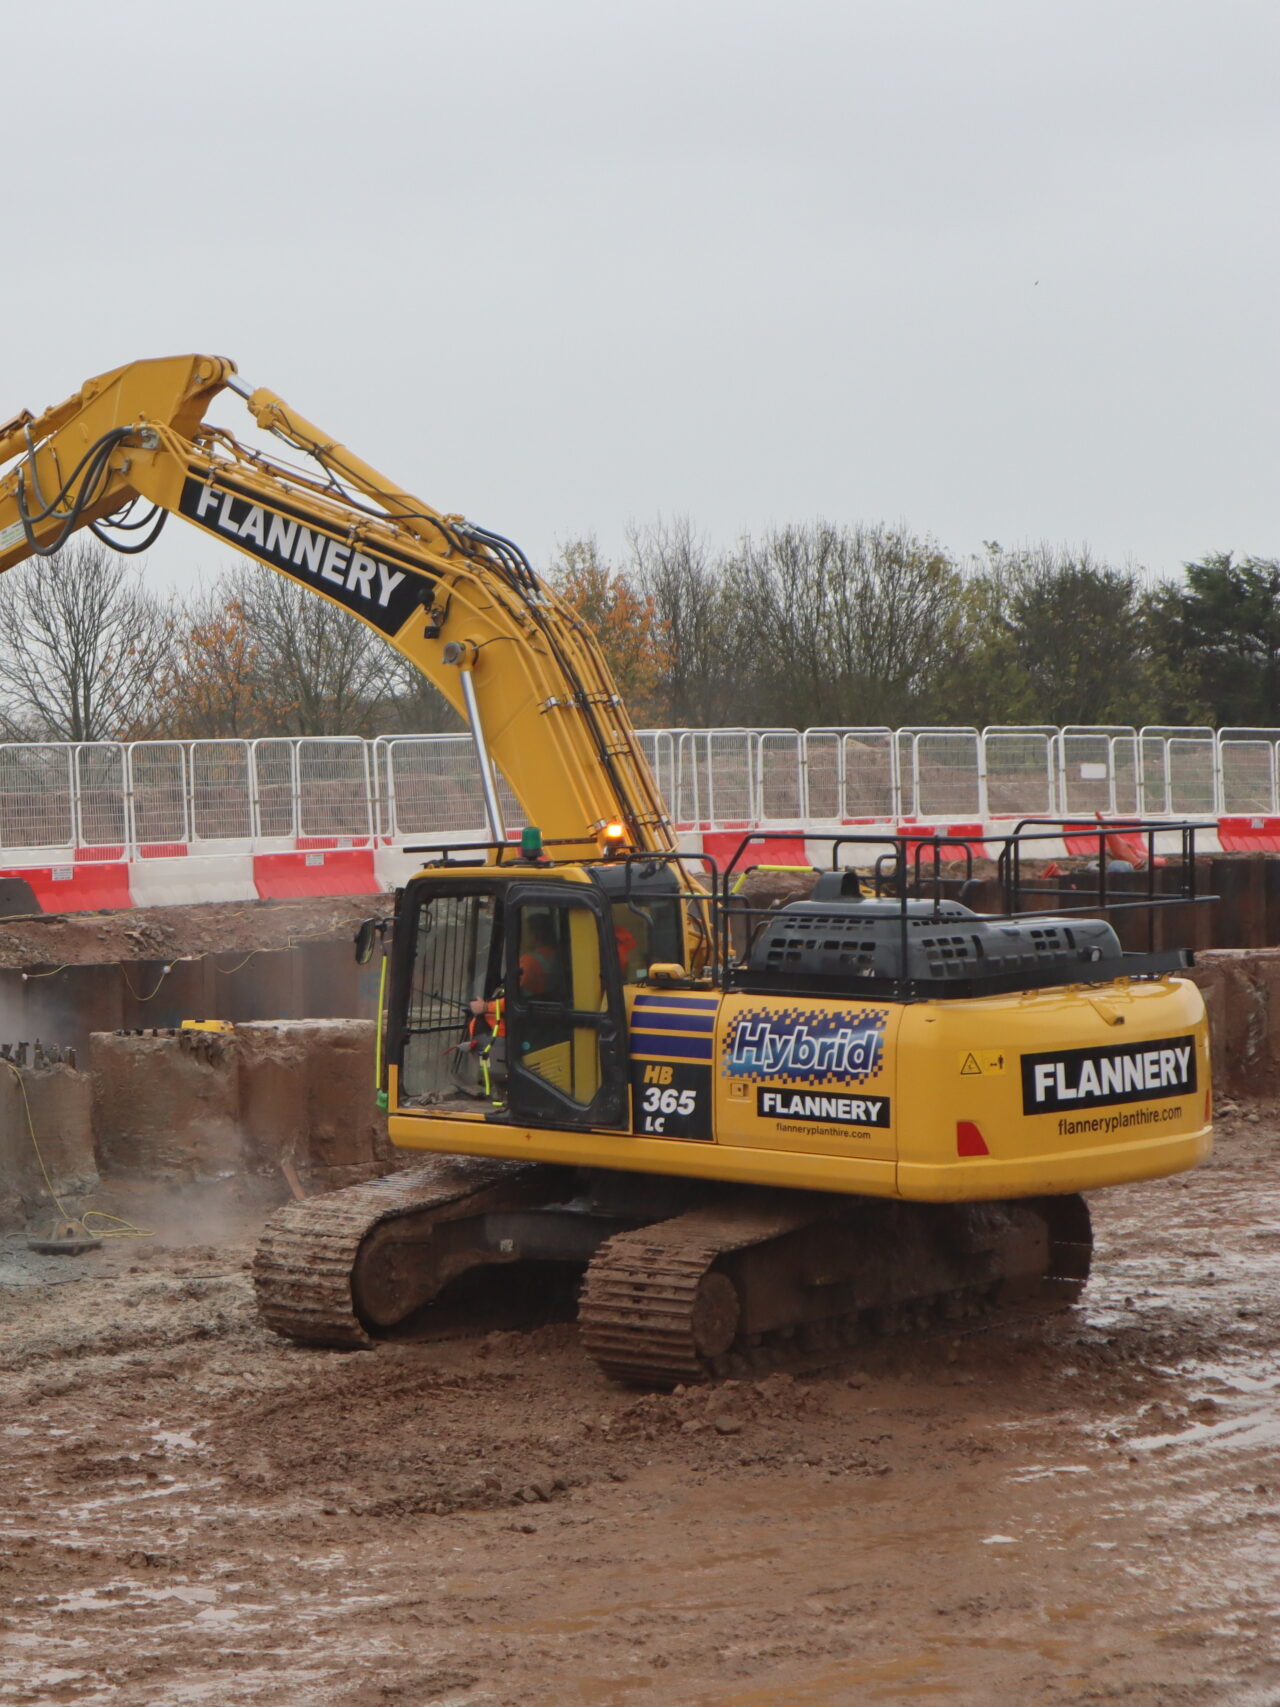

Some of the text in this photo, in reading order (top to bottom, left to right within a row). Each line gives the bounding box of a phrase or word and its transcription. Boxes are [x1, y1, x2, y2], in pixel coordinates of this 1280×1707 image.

[196, 484, 406, 608] FLANNERY
[733, 1021, 878, 1074] Hybrid
[643, 1064, 674, 1085] HB
[1034, 1045, 1191, 1103] FLANNERY
[642, 1087, 697, 1116] 365
[762, 1092, 883, 1122] FLANNERY
[644, 1116, 665, 1133] LC
[775, 1122, 871, 1139] flanneryplanthire.com
[1058, 1105, 1182, 1136] flanneryplanthire.com
